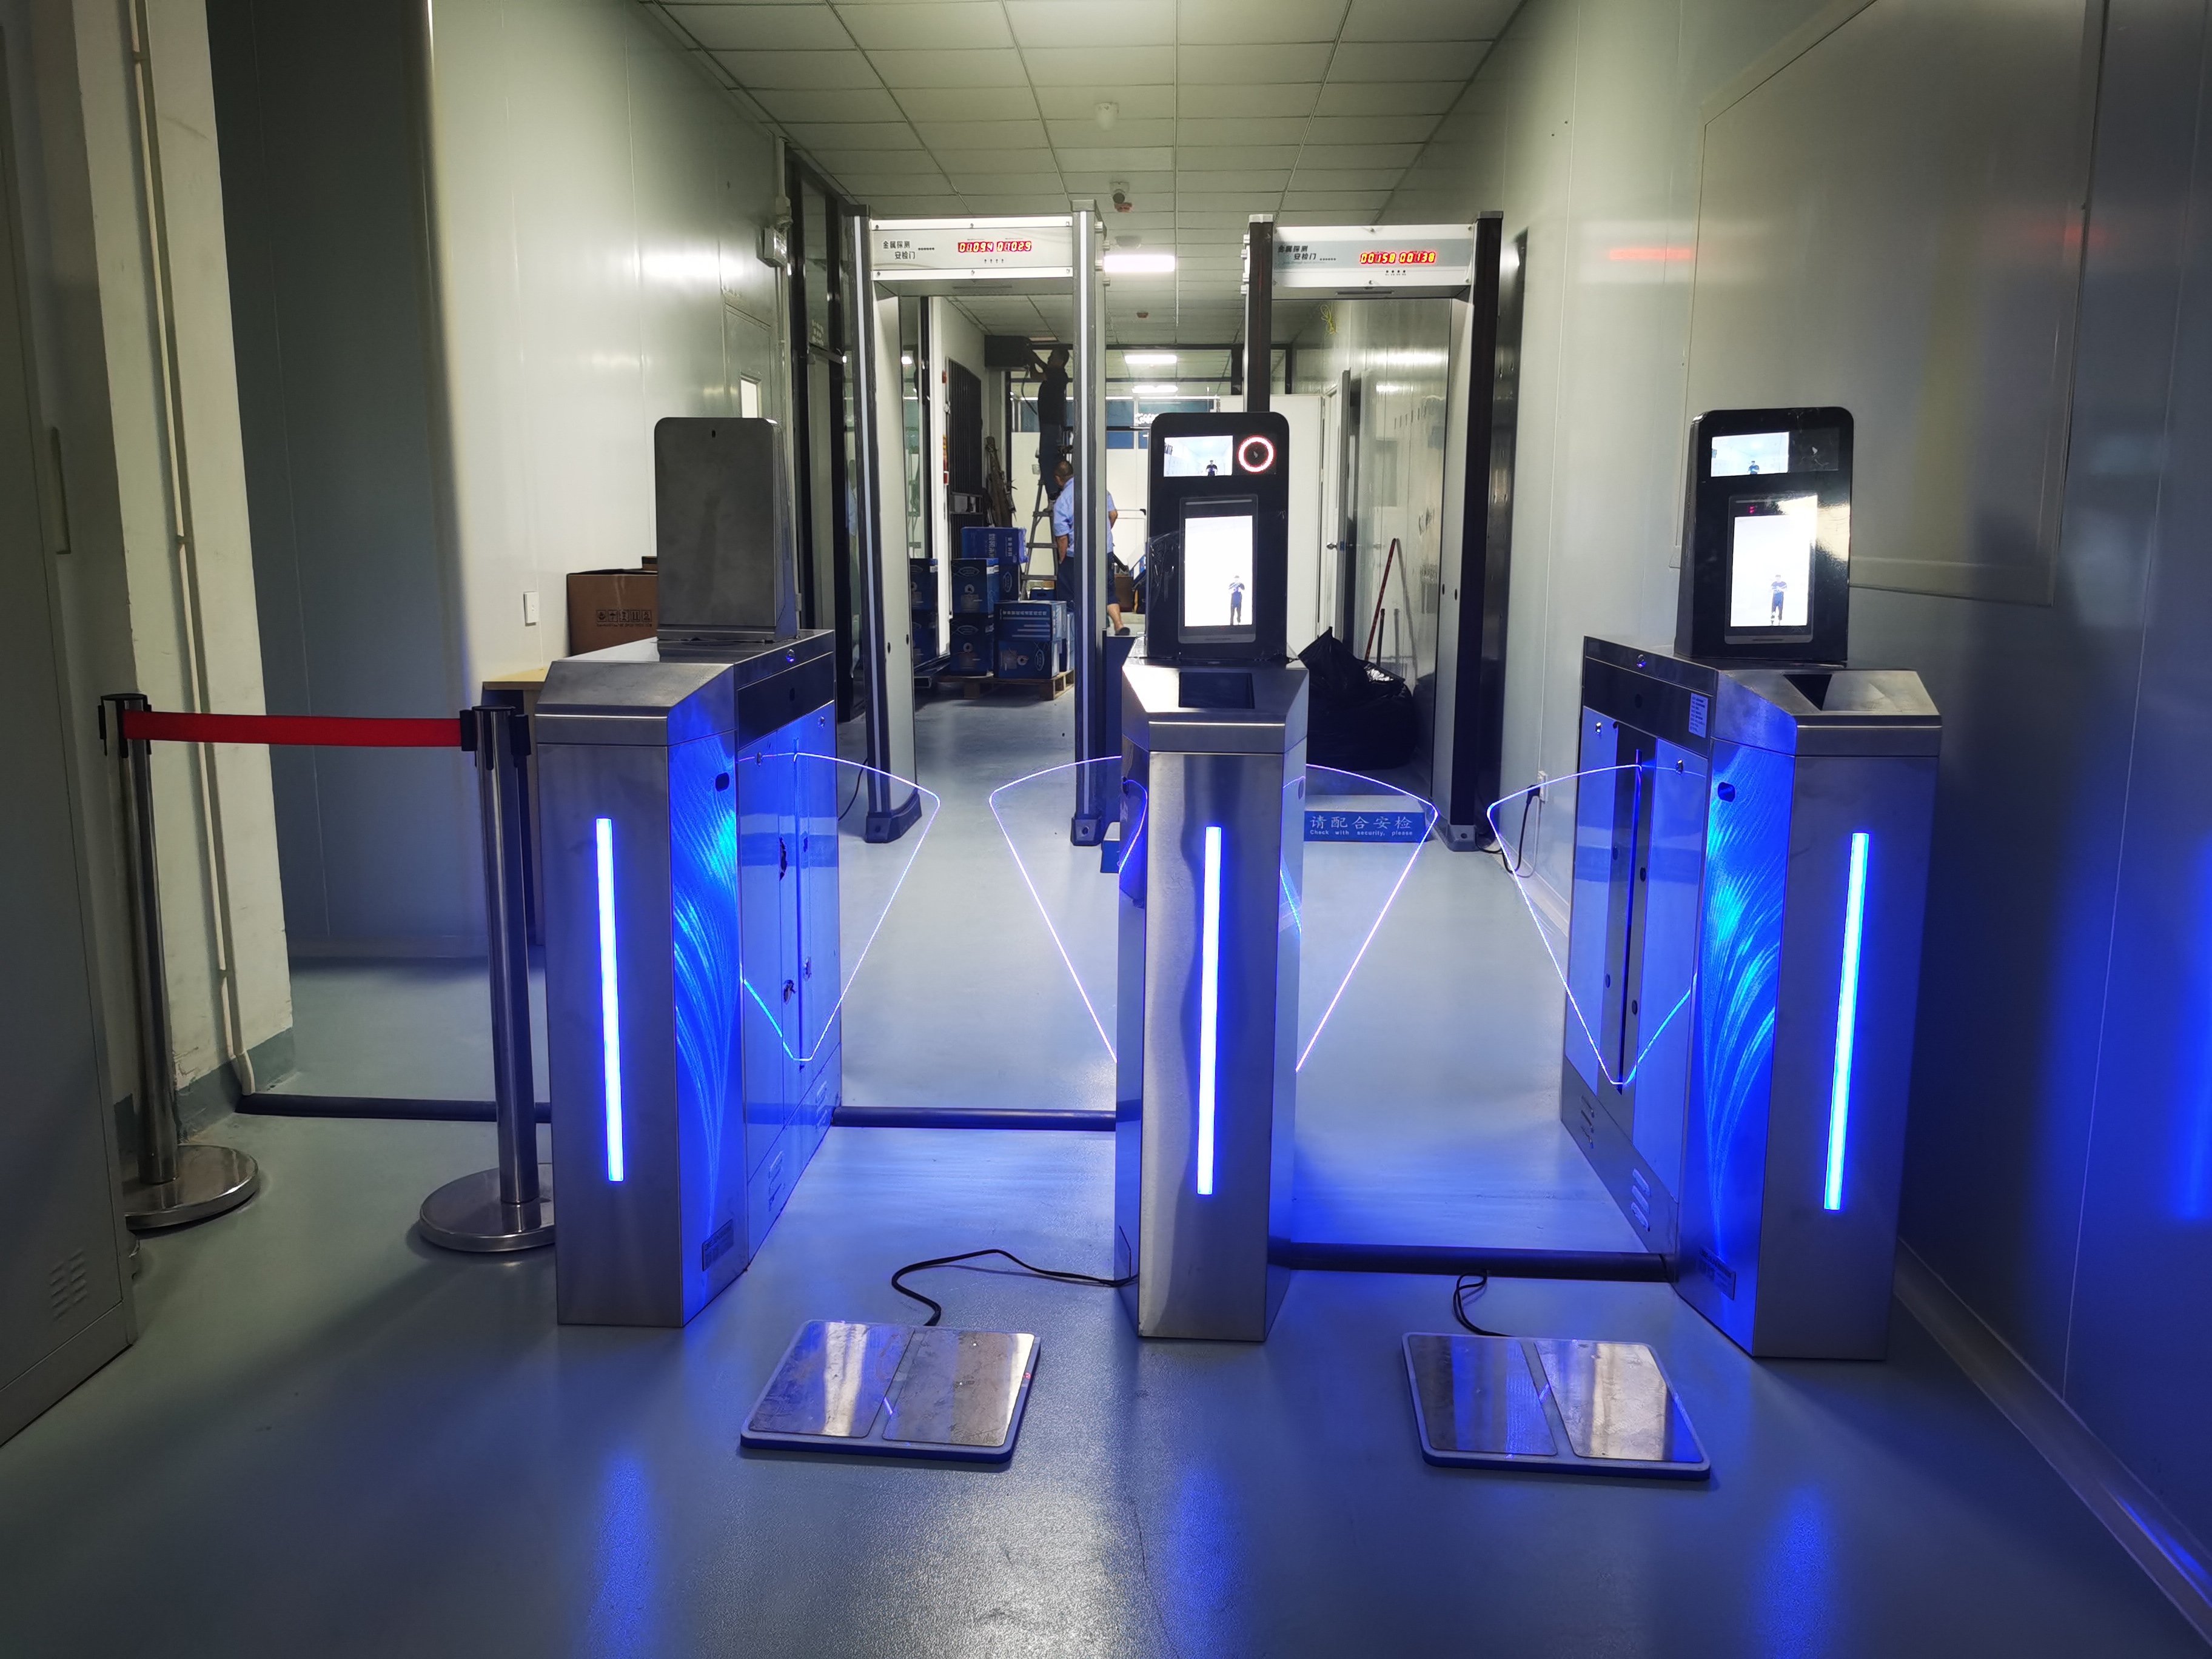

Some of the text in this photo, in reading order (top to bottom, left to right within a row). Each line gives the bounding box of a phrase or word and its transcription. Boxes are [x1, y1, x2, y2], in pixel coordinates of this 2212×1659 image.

[895, 251, 916, 260] 安检门
[1310, 815, 1412, 830] 请配合安检
